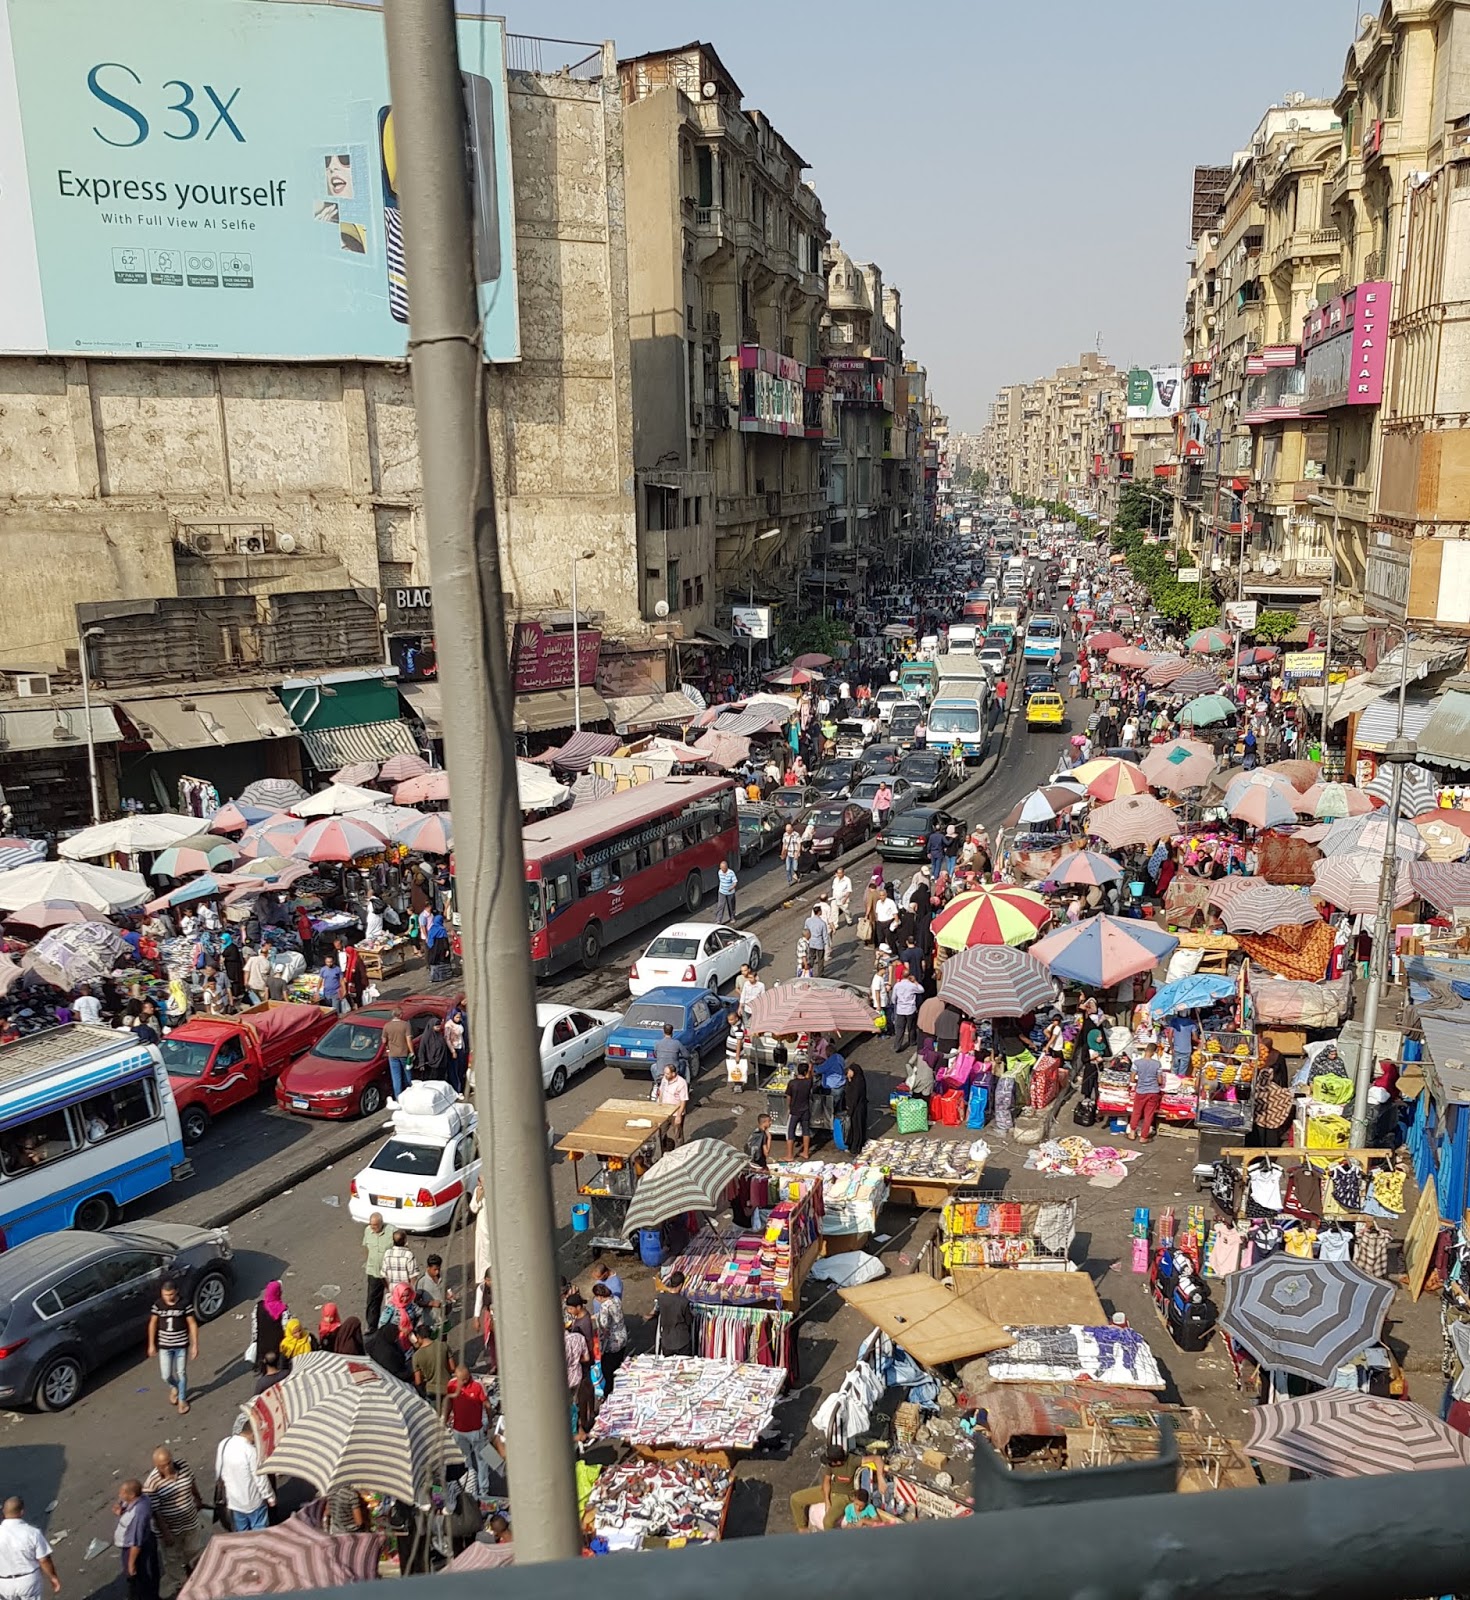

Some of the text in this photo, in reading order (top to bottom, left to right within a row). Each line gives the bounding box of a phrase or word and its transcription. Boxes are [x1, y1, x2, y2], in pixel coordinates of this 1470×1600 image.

[57, 169, 287, 211] Express yourself
[101, 212, 256, 231] With Full View AI Selfie
[1357, 292, 1377, 394] ELTAIAR
[166, 1317, 174, 1332] 1
